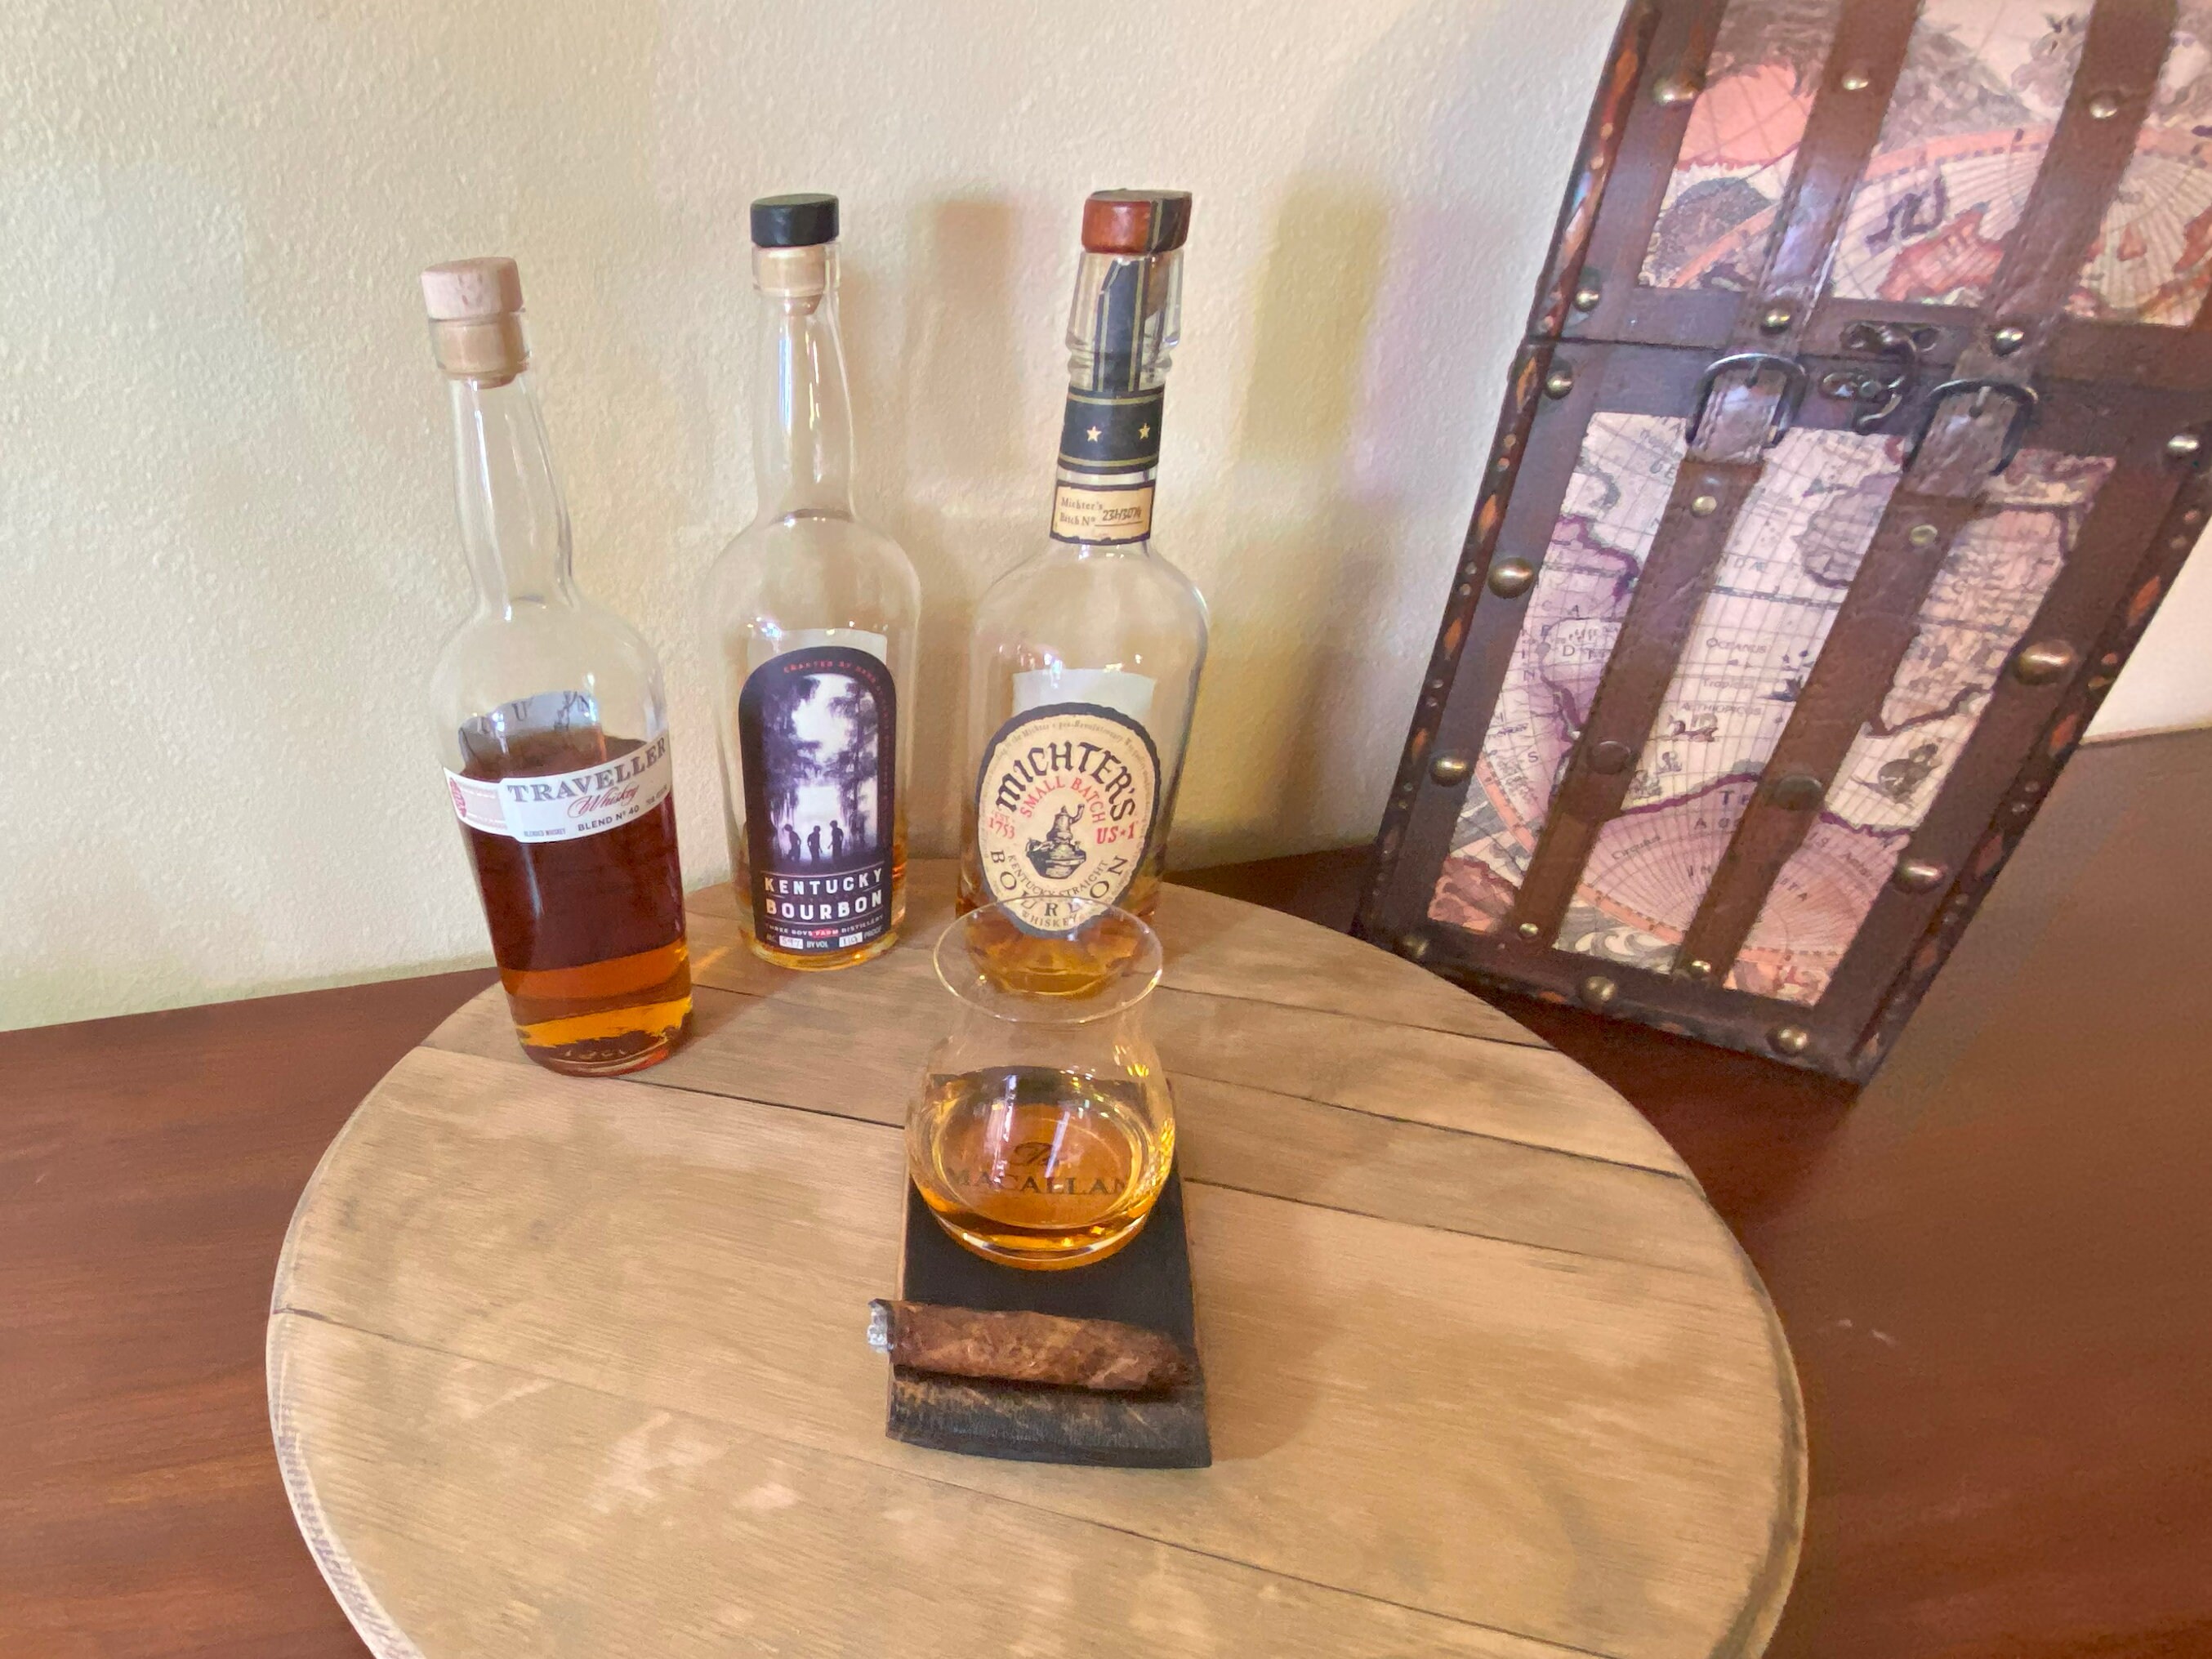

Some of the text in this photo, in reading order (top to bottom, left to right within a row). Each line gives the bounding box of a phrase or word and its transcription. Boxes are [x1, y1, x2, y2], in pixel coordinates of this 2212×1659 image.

[1061, 497, 1104, 511] Michter's
[1059, 512, 1080, 524] Batch
[1706, 636, 1768, 653] OCEANUS
[507, 736, 667, 802] TRAVELLER
[995, 740, 1136, 822] MICHTER'S
[567, 782, 640, 818] Whiskey
[1019, 776, 1066, 819] SMALL
[1069, 777, 1107, 823] BATCH
[546, 827, 566, 836] WHISKEY
[577, 816, 614, 832] BLEND
[628, 805, 640, 815] 40
[988, 817, 1015, 840] 1753
[764, 867, 882, 895] KENTUCKY
[1059, 859, 1108, 897] STRAIGHT
[765, 889, 882, 921] BOURBON
[1020, 909, 1078, 928] WHISKEY
[765, 914, 884, 937] THREE BOYS FARM DISTILLERY
